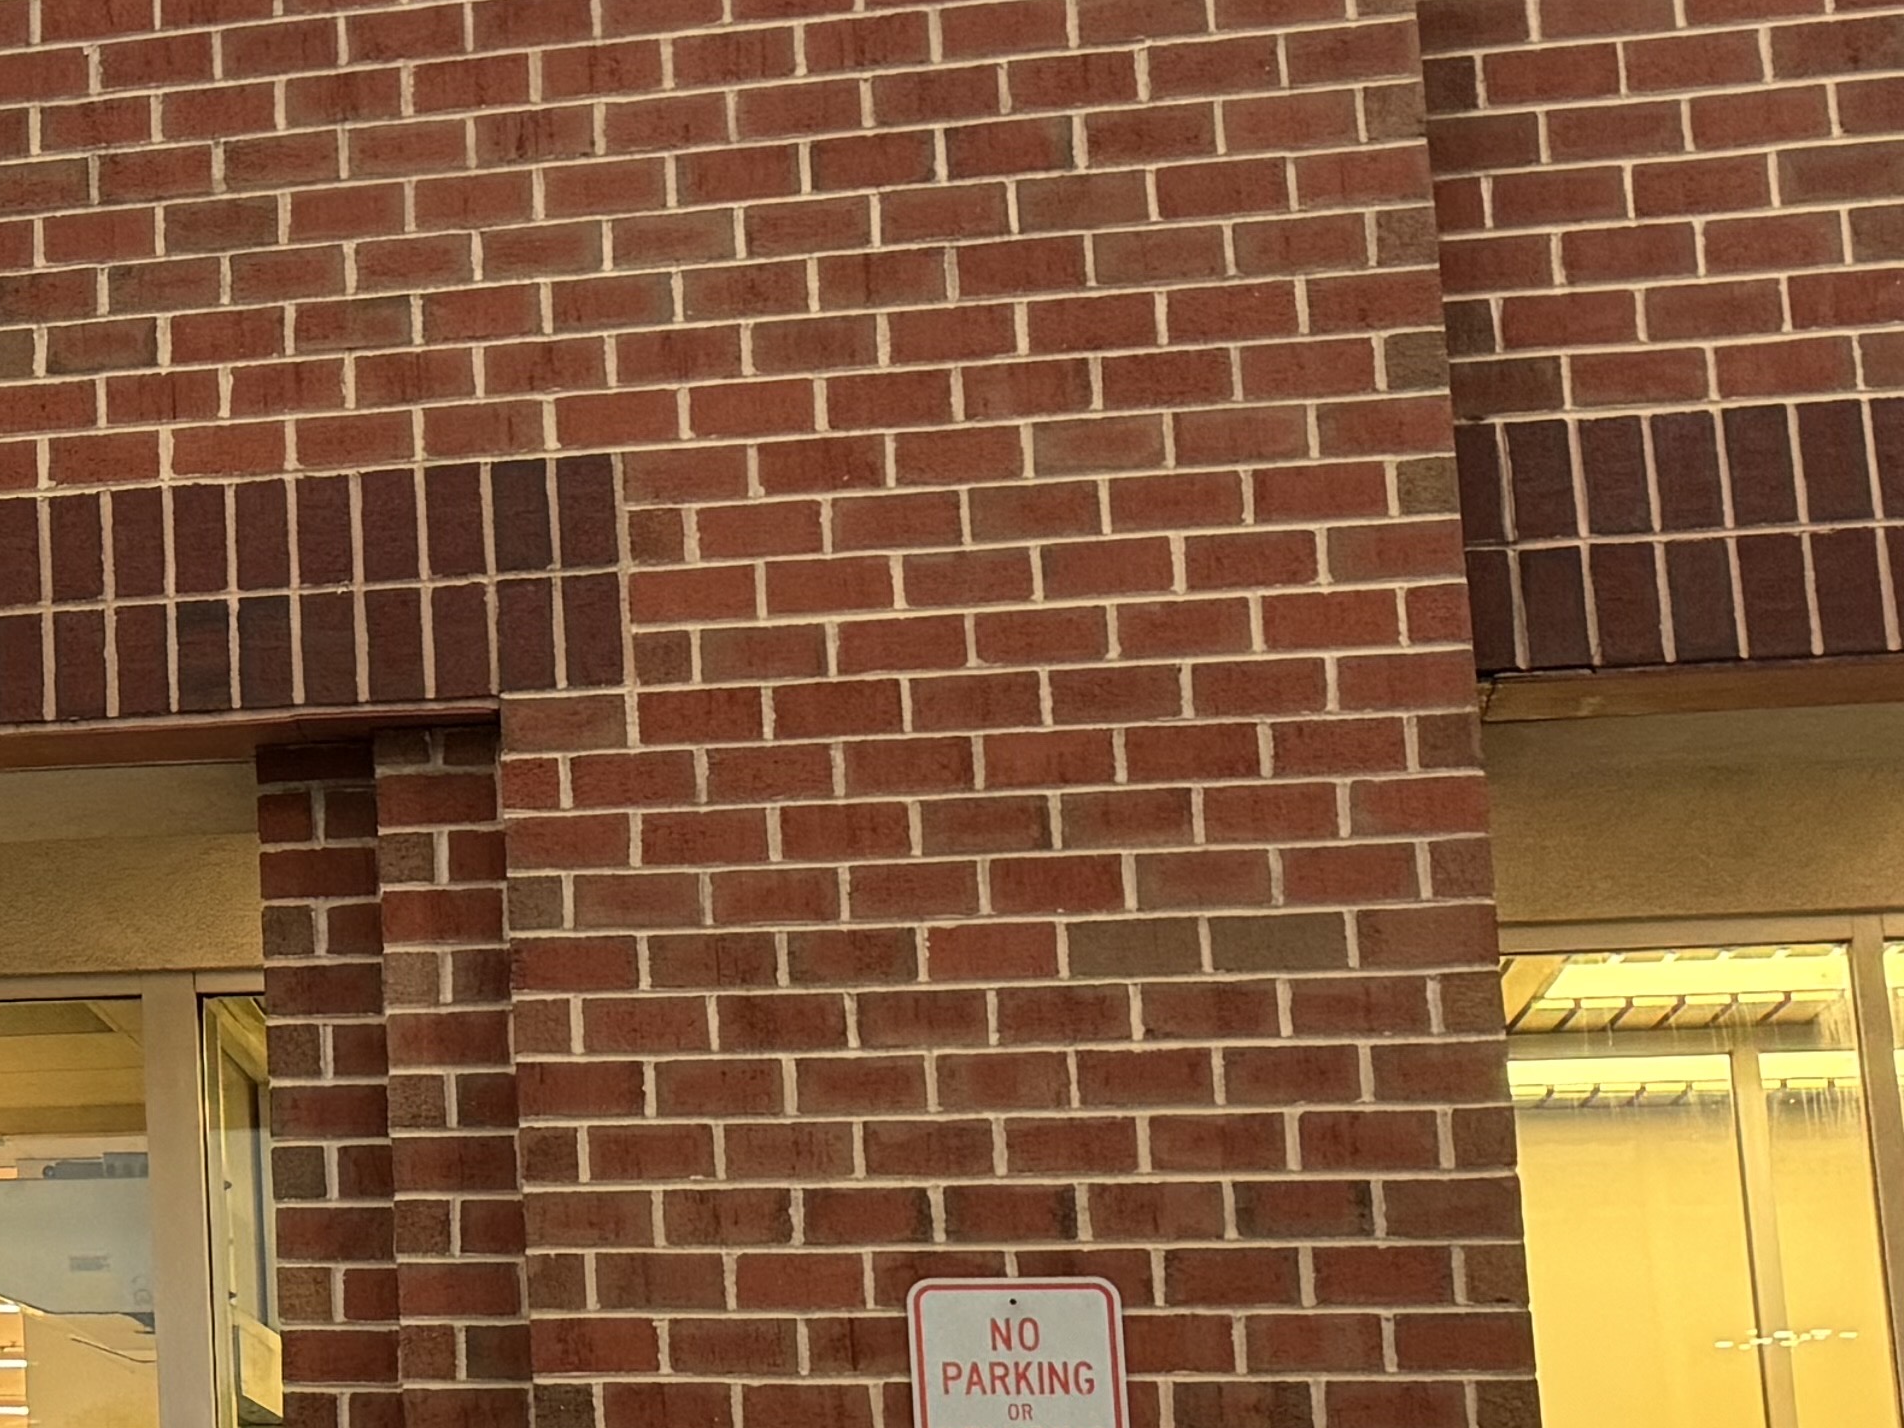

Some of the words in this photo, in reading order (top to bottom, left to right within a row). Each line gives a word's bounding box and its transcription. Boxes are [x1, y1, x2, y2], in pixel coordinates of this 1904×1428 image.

[989, 1317, 1041, 1352] NO
[941, 1361, 1095, 1396] PARKING
[1007, 1403, 1034, 1421] OR
